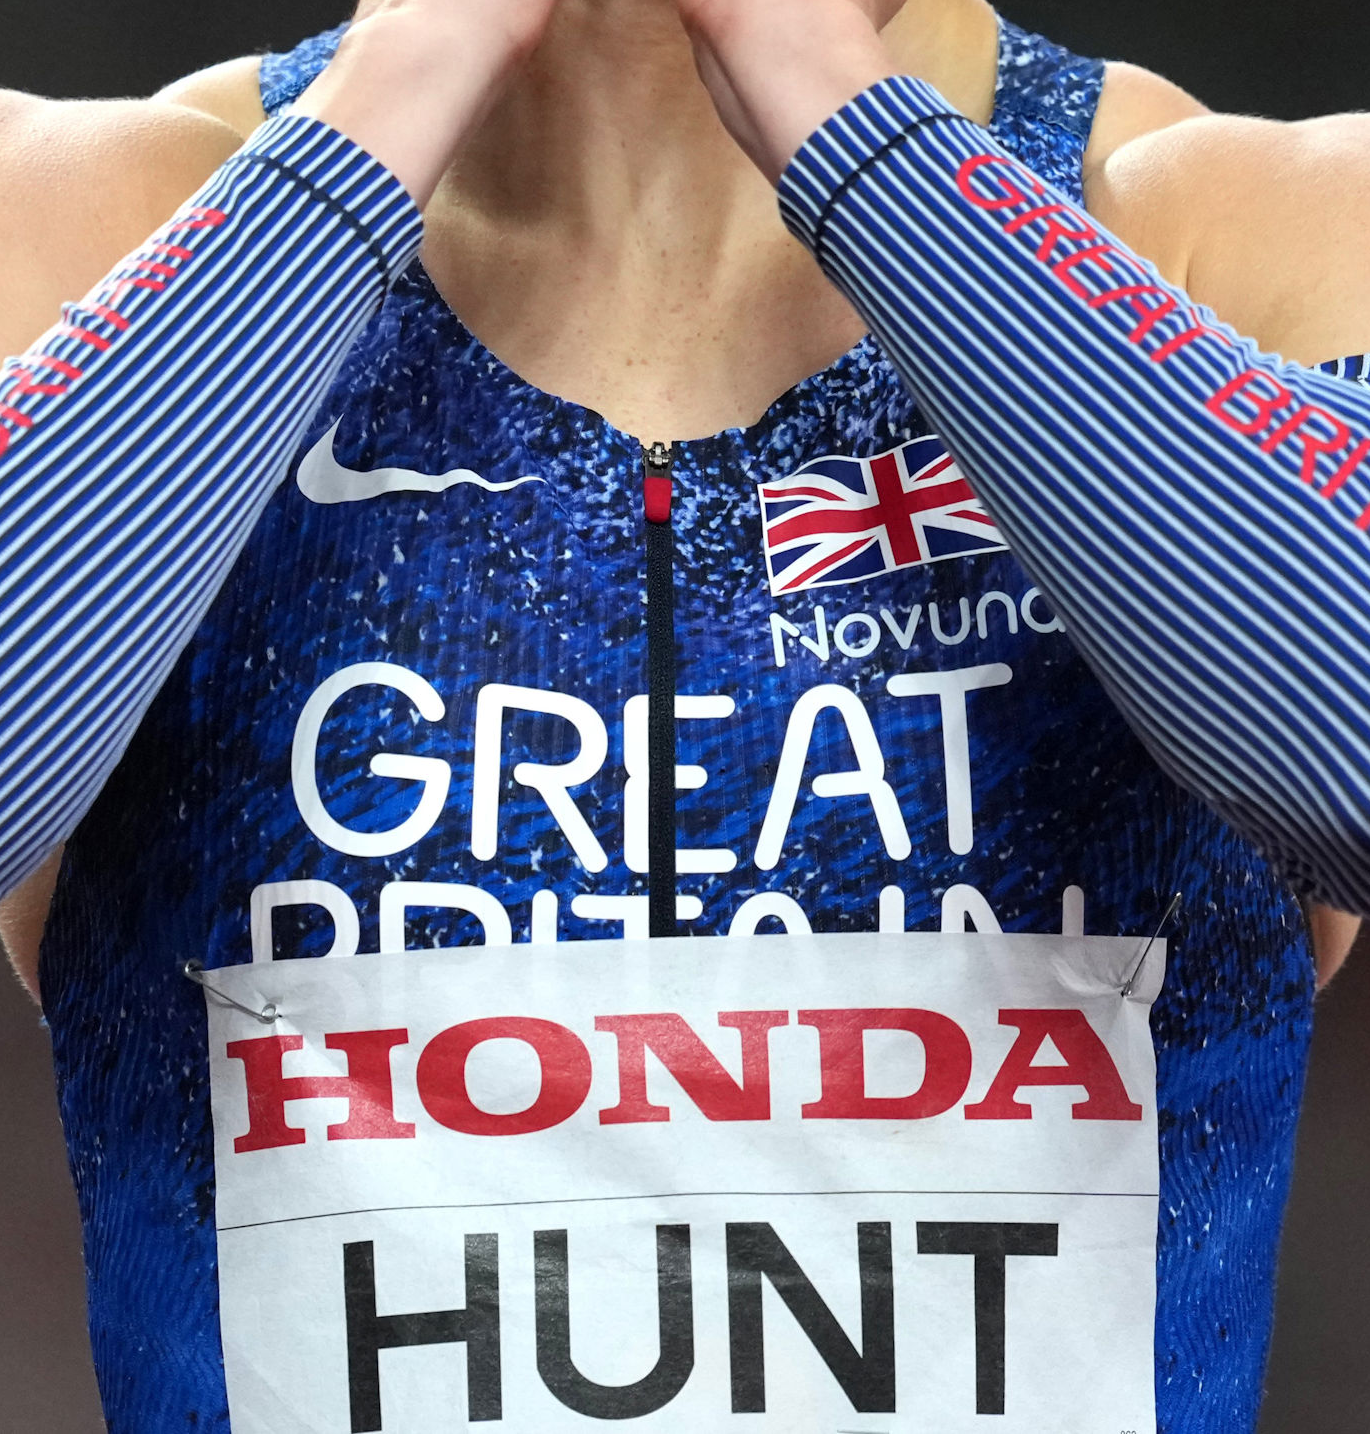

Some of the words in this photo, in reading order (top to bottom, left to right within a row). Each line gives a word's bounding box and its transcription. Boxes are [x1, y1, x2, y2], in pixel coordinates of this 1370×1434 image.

[954, 153, 1233, 363] GREAT
[290, 659, 1013, 874] GREAT
[227, 1007, 1143, 1154] HONDA
[342, 1221, 1059, 1434] HUNT
